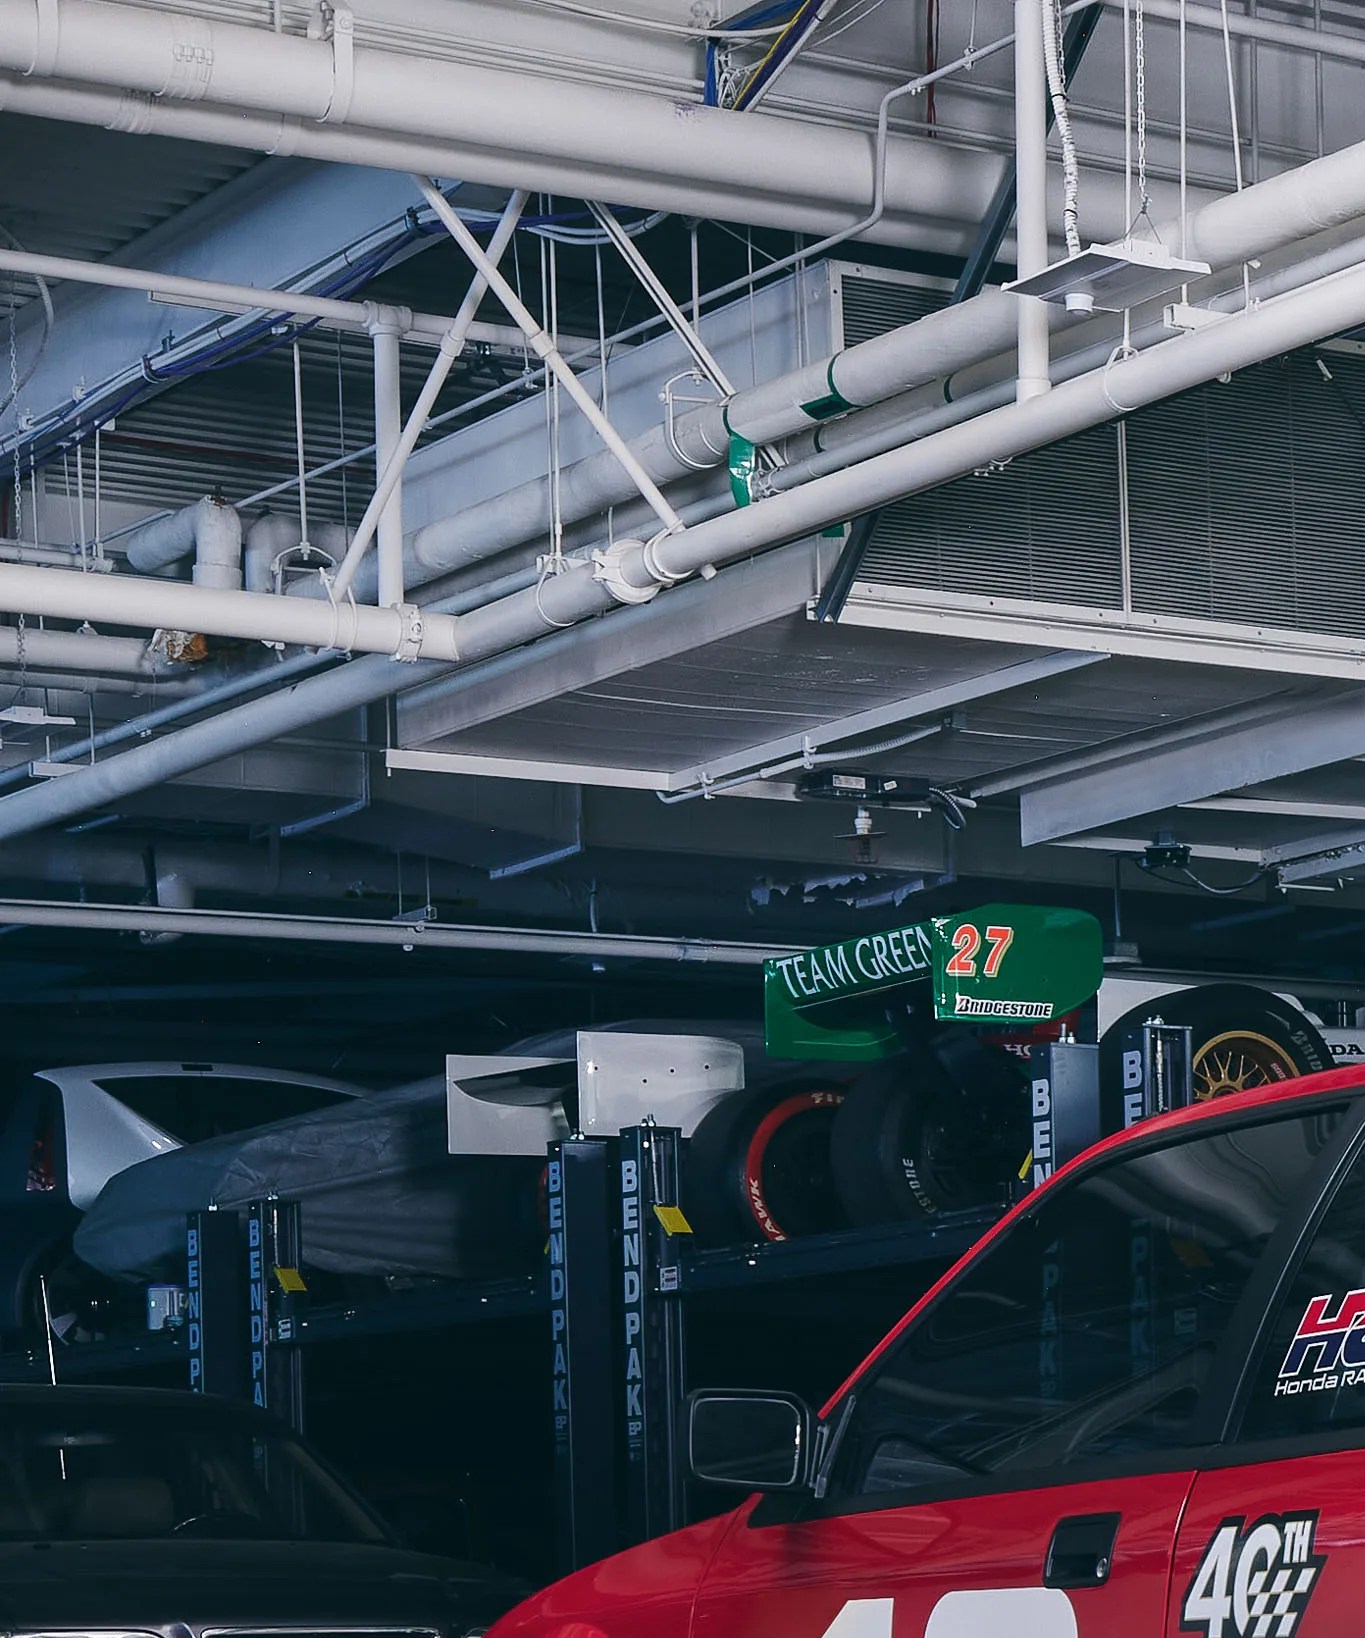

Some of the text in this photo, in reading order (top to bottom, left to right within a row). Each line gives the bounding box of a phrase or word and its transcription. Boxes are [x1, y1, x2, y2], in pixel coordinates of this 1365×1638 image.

[778, 946, 856, 998] TEAM
[946, 924, 1012, 976] 27
[956, 998, 1053, 1018] BRIDGESTONE
[187, 1229, 200, 1393] BENDP
[621, 1160, 643, 1417] BENDPAK
[1274, 1373, 1339, 1396] Honda
